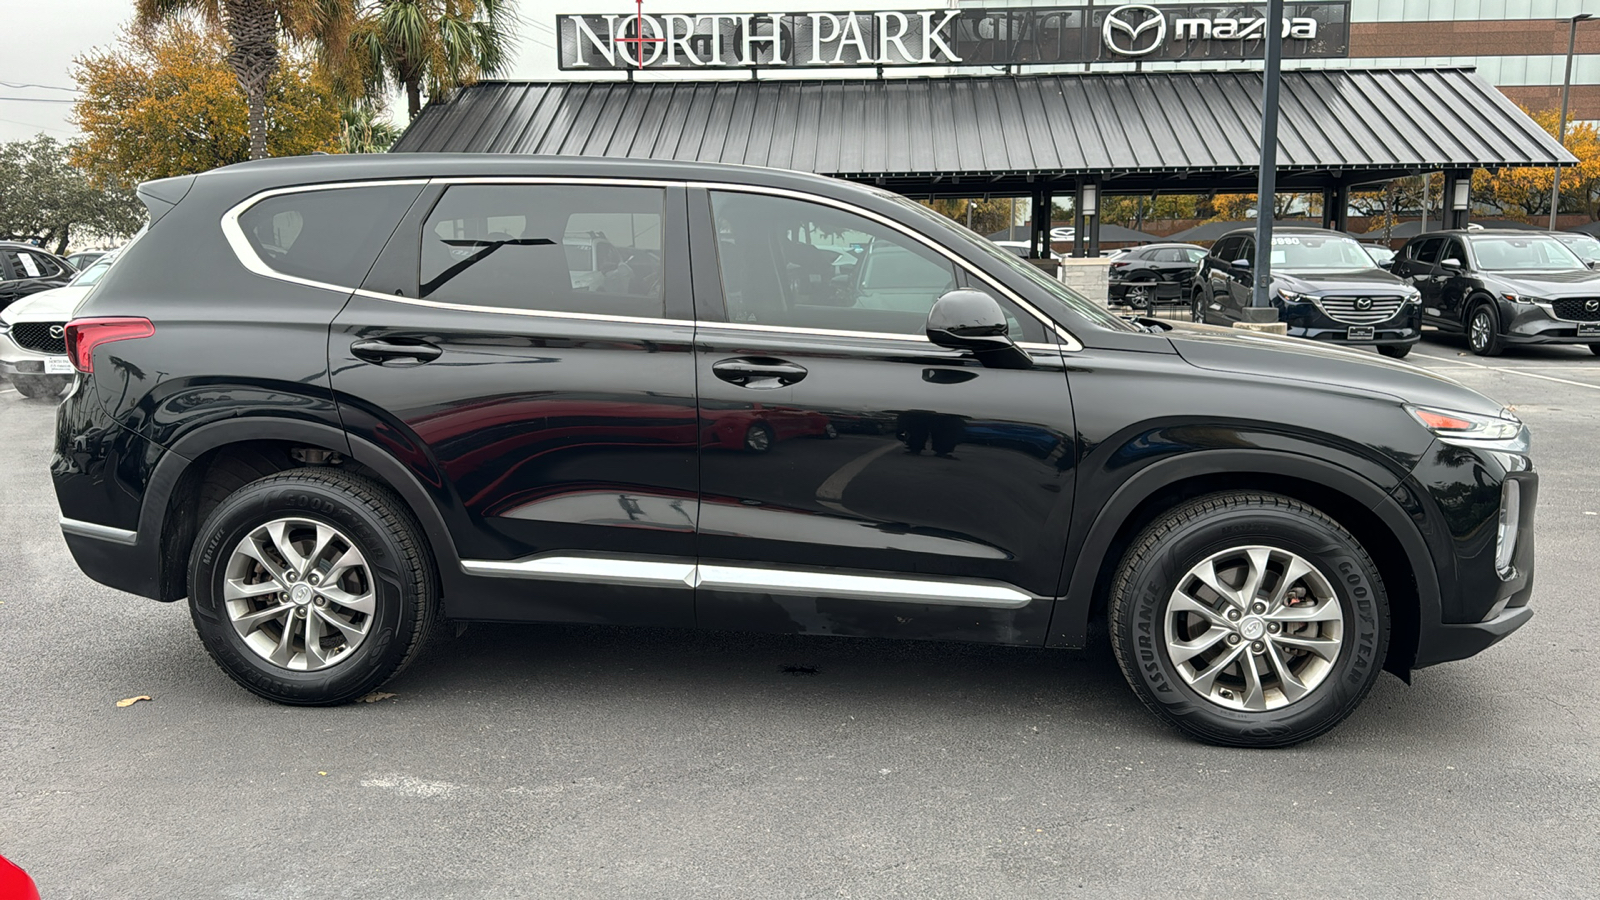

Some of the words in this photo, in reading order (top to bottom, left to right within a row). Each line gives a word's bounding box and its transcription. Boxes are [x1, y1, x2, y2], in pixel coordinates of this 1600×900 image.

[568, 13, 788, 67] NORTH
[806, 10, 963, 64] PARK
[1338, 561, 1372, 613] GOOD
[1137, 580, 1173, 694] ASSURANCE
[1346, 630, 1374, 686] YEAR
